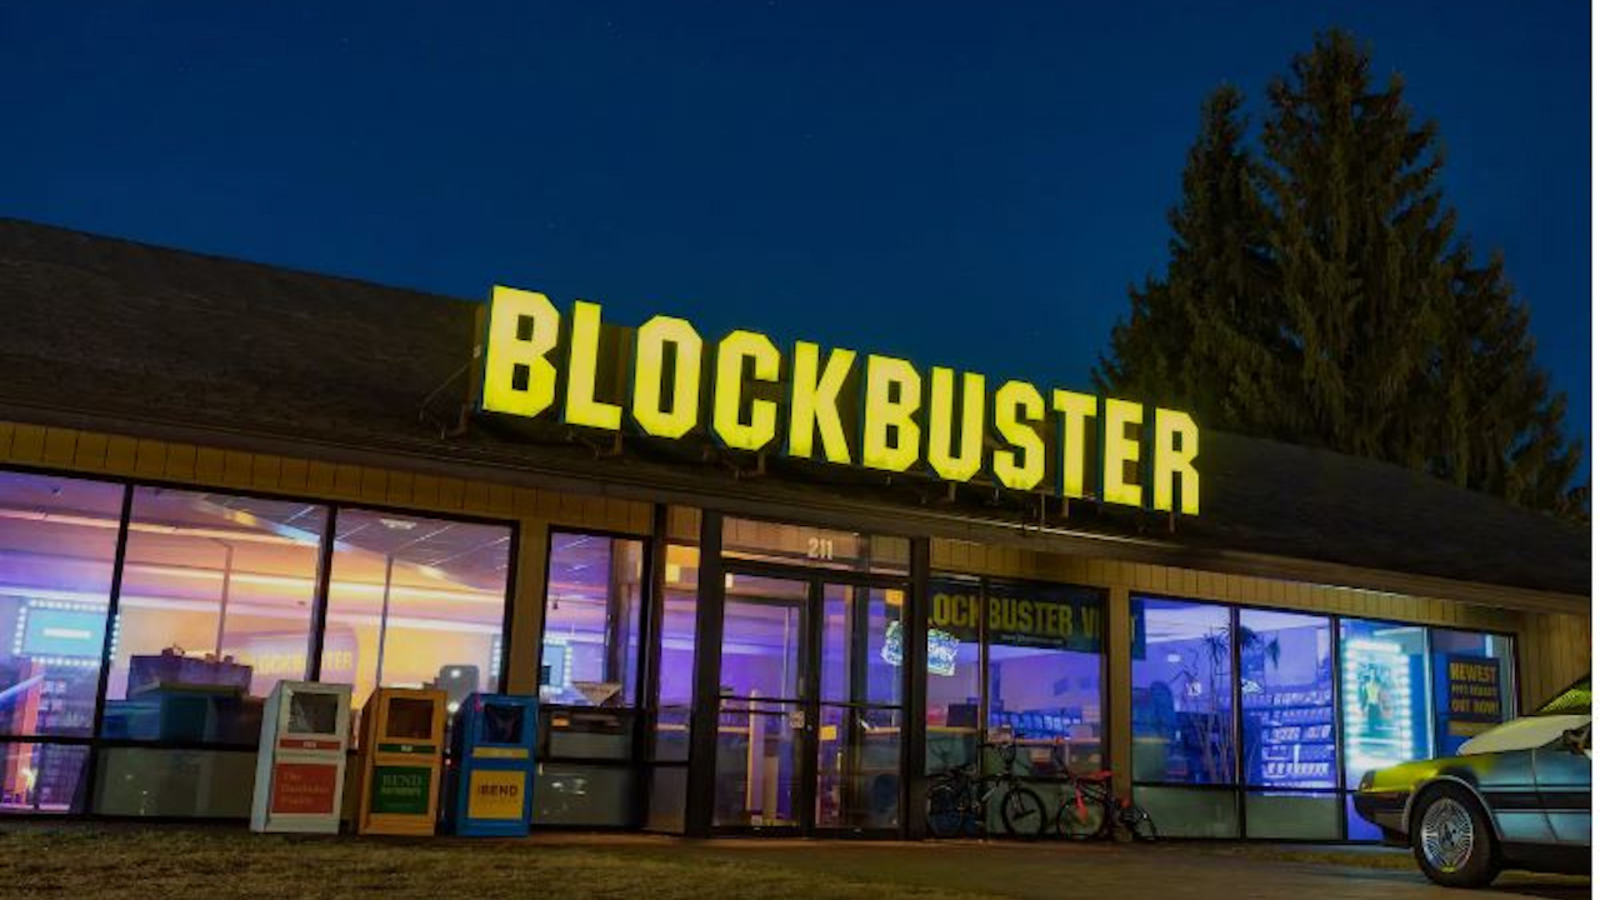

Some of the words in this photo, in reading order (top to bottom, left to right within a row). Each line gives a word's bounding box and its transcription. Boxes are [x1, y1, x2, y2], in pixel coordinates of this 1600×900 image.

[482, 285, 1200, 515] BLOCKBUSTER
[808, 538, 834, 560] 211
[1450, 662, 1497, 683] NEWEST
